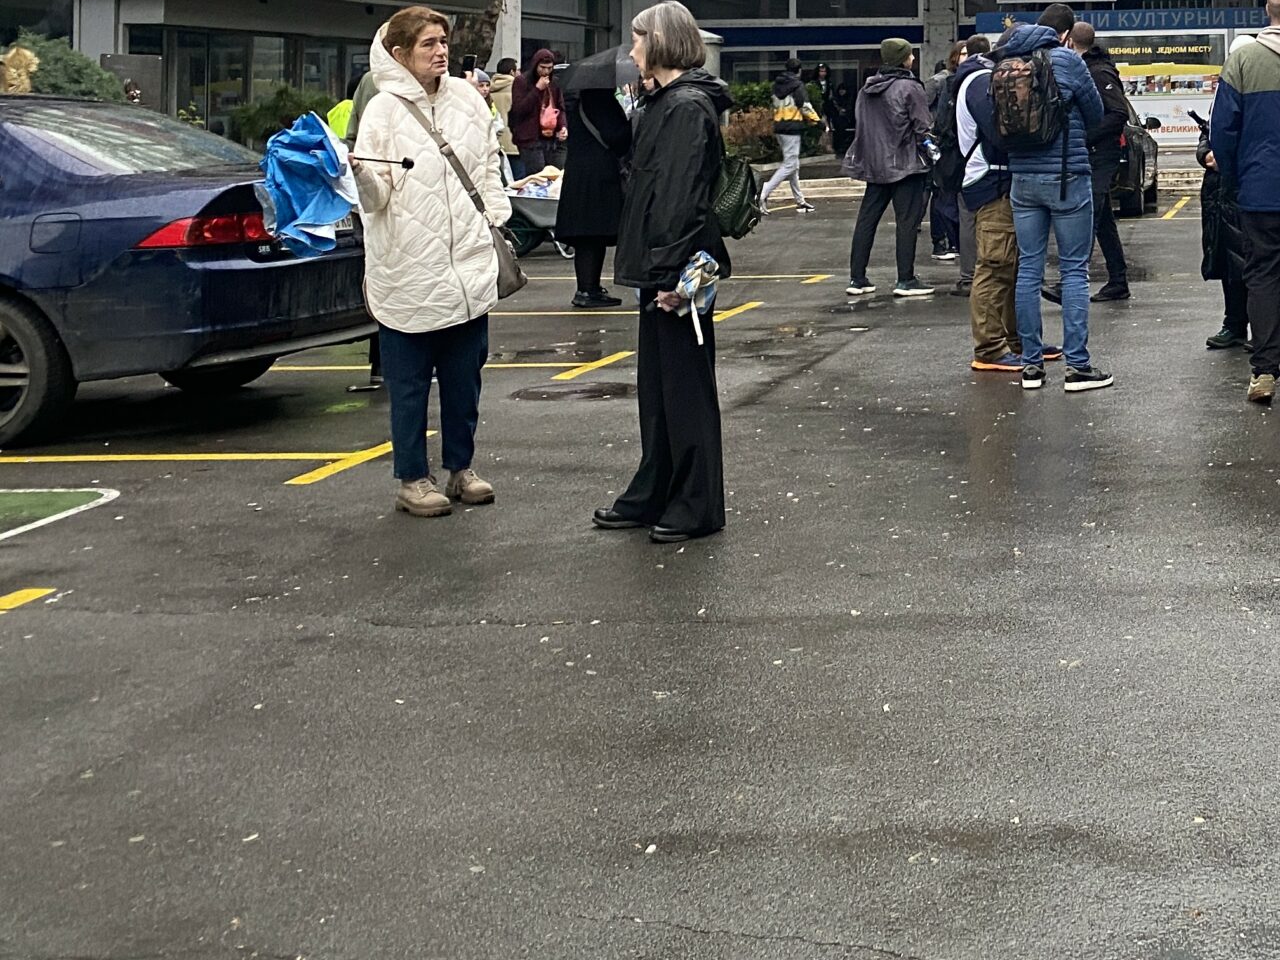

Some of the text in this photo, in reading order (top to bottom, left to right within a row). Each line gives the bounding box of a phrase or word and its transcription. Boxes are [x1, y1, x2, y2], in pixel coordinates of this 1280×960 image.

[1118, 11, 1225, 28] КУЛТУРНИ
[1156, 46, 1187, 55] ЈЕДНОМ
[1188, 45, 1213, 53] МЕСТУ
